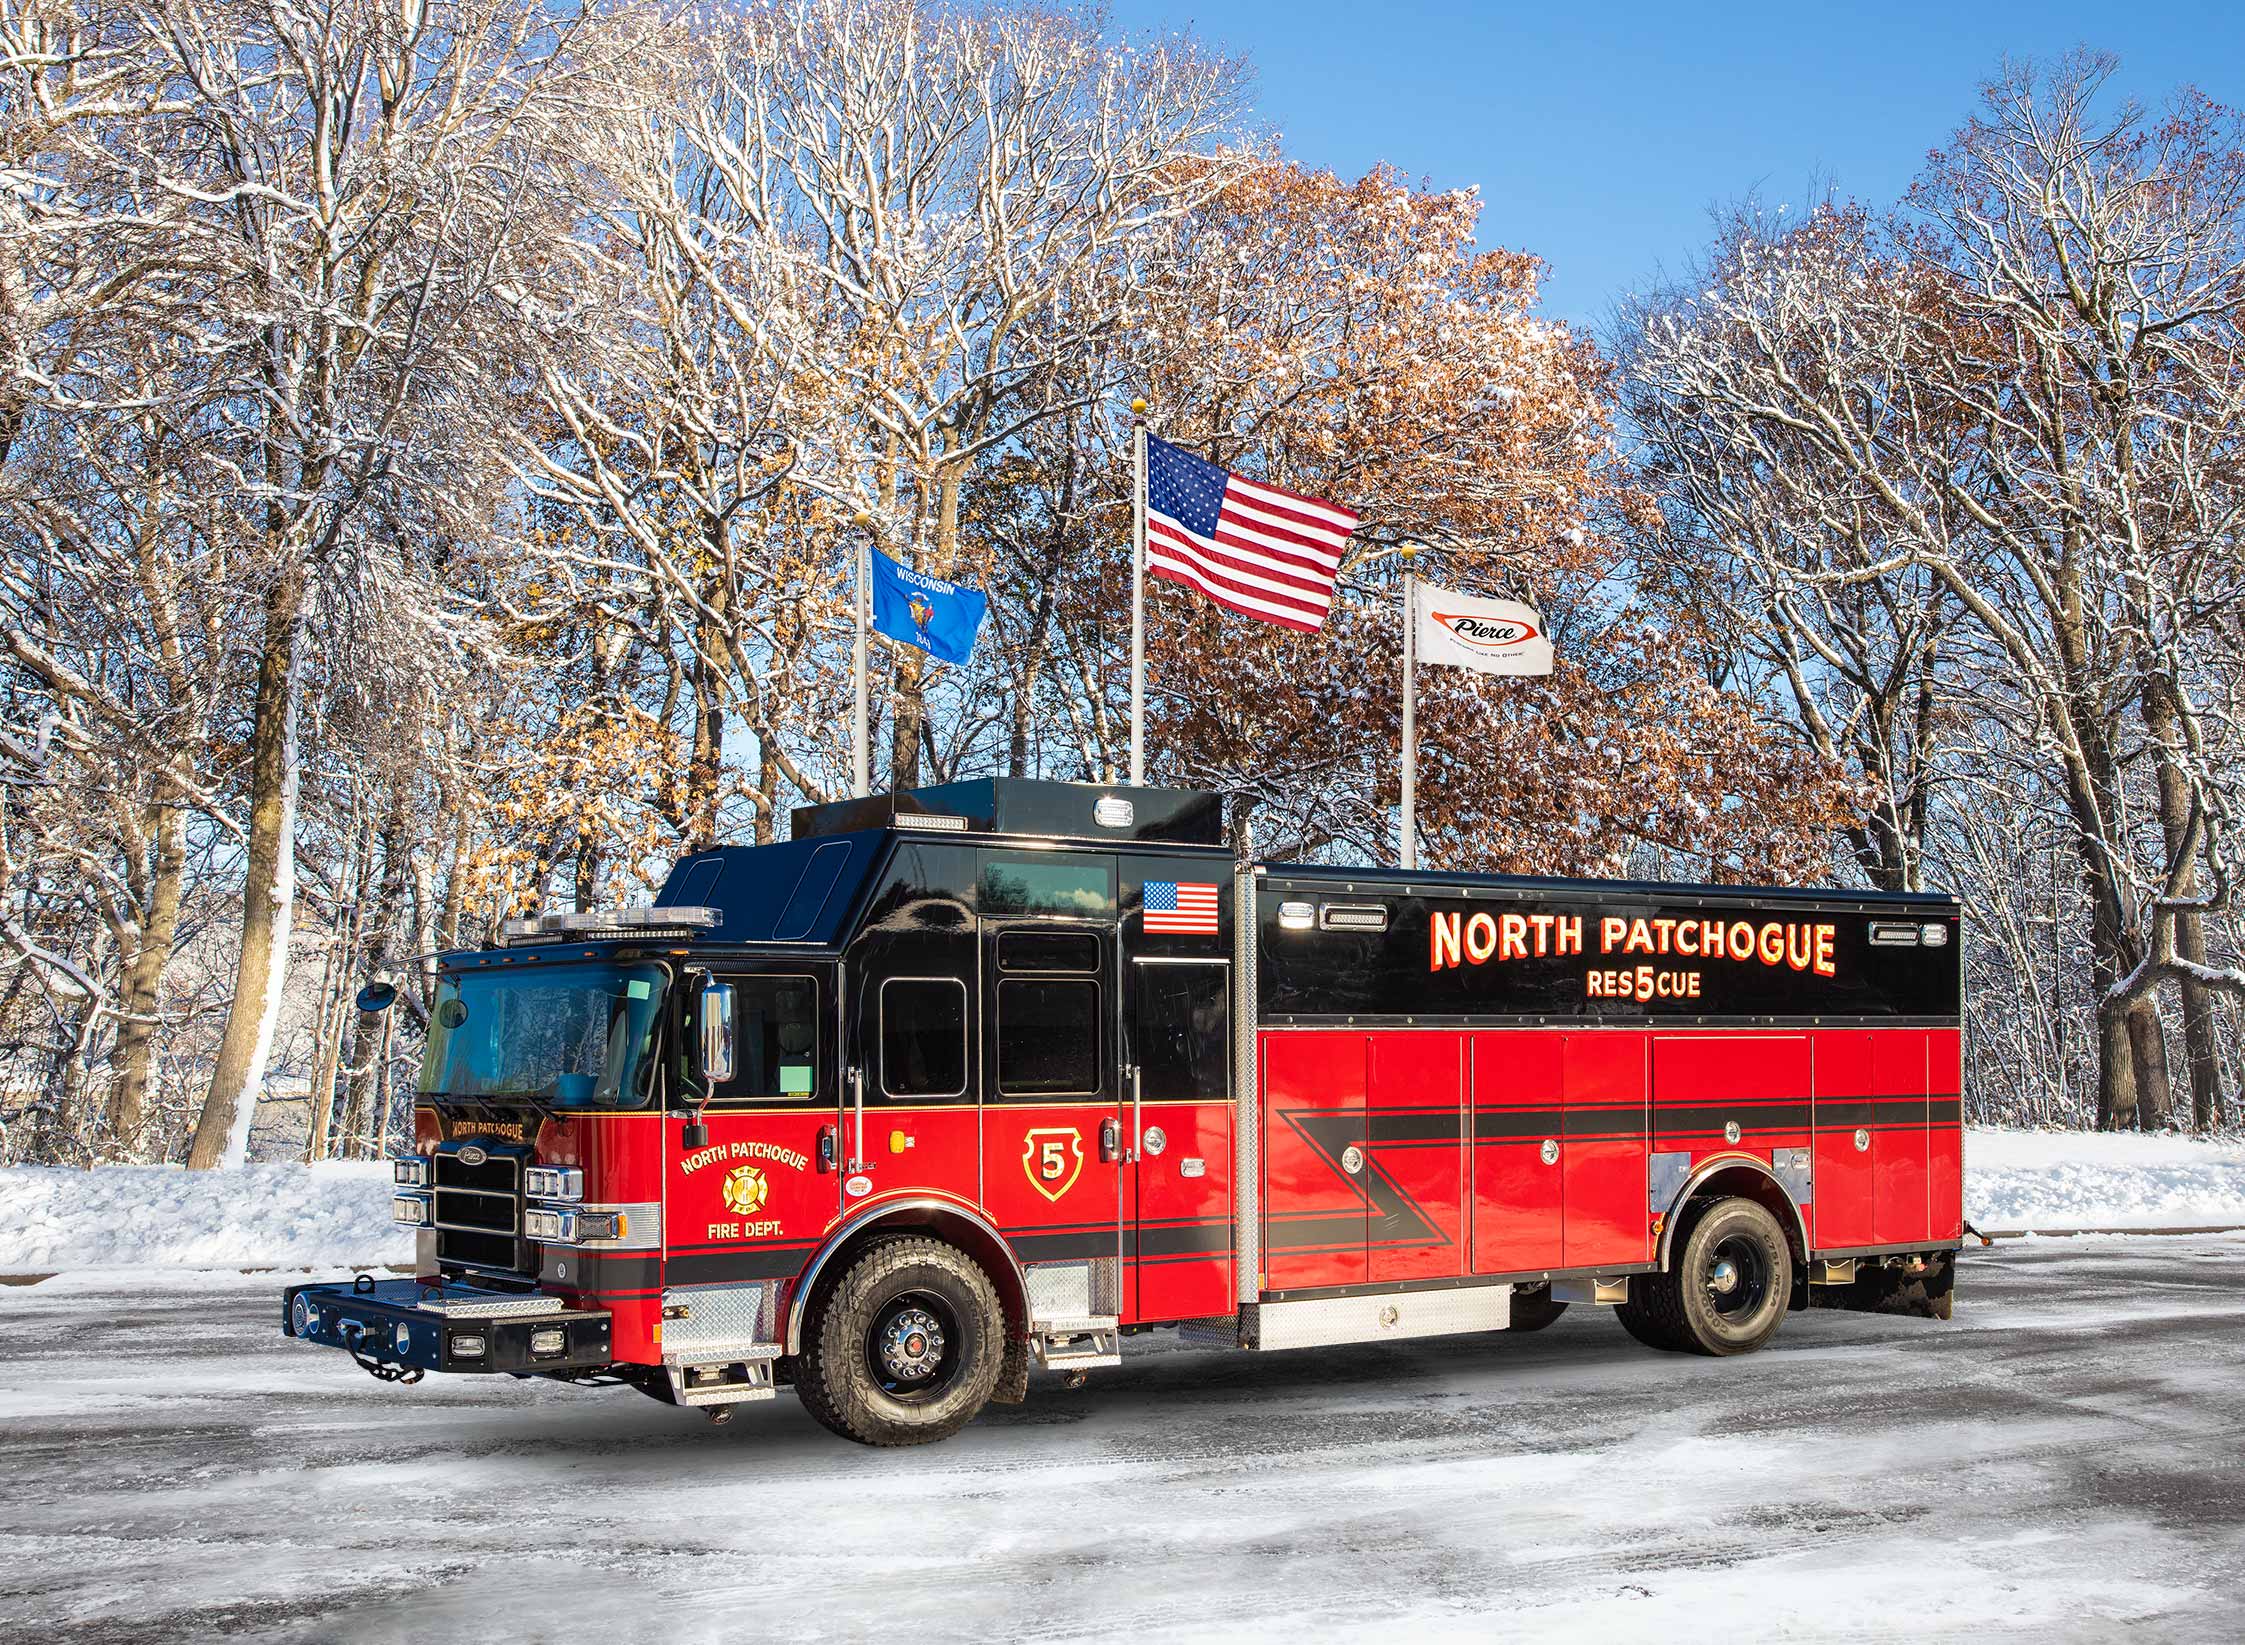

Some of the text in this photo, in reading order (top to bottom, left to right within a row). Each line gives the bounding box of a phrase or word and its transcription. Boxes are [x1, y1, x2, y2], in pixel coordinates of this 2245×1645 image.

[896, 566, 956, 596] WISCONSIN
[1454, 618, 1516, 640] Pierce
[1430, 911, 1836, 977] NORTH PATCHOGUE
[452, 1120, 477, 1137] NORTH
[680, 1141, 809, 1176] NORTH PATCHOGUE
[1041, 1142, 1065, 1181] 5
[707, 1220, 784, 1240] FIRE DEPT.
